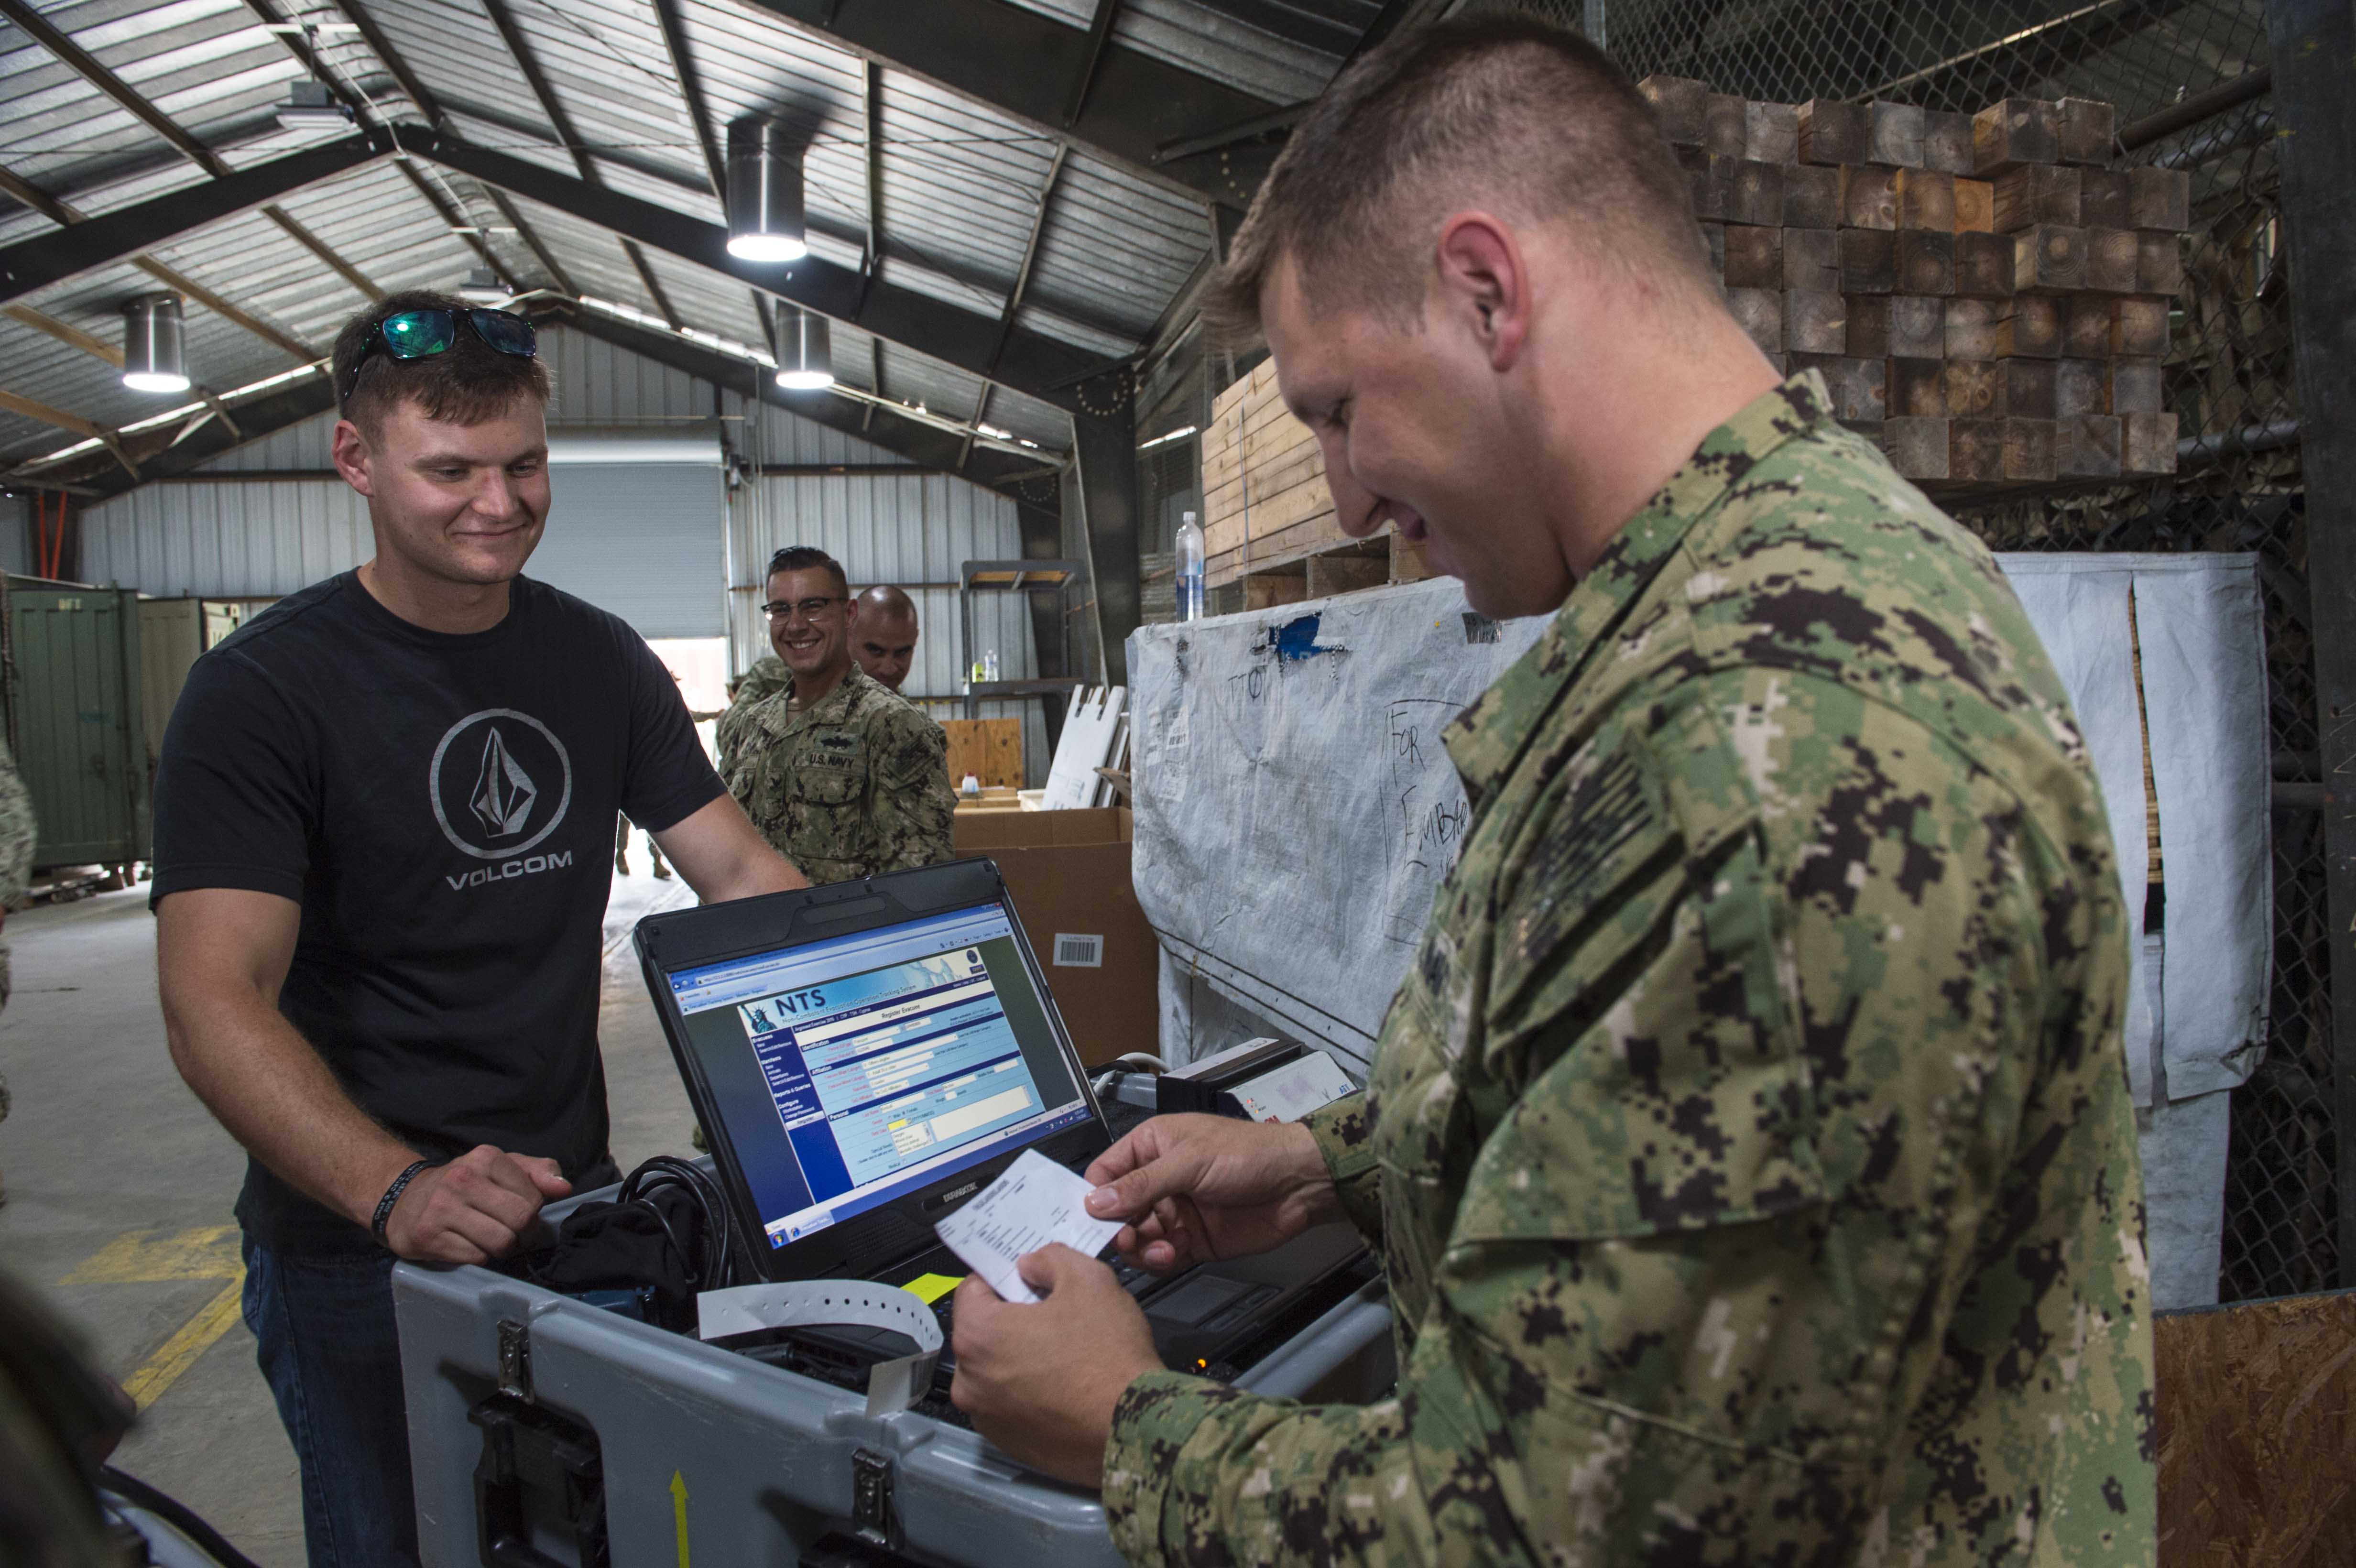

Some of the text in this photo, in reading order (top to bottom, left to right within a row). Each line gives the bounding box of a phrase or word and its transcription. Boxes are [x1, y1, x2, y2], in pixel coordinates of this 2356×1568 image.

[1391, 708, 1427, 787] FOR
[810, 754, 854, 769] U.S. NAVY
[446, 850, 573, 891] VOLCOM
[775, 989, 826, 1017] NTS
[825, 1001, 853, 1013] Evacuation
[879, 989, 900, 998] Tracking
[881, 1004, 920, 1018] Register Evacuee
[802, 1040, 829, 1051] Identification
[811, 1066, 832, 1075] Affiliation
[773, 1089, 791, 1098] Reports
[794, 1083, 811, 1091] Queries
[829, 1109, 850, 1121] Personal
